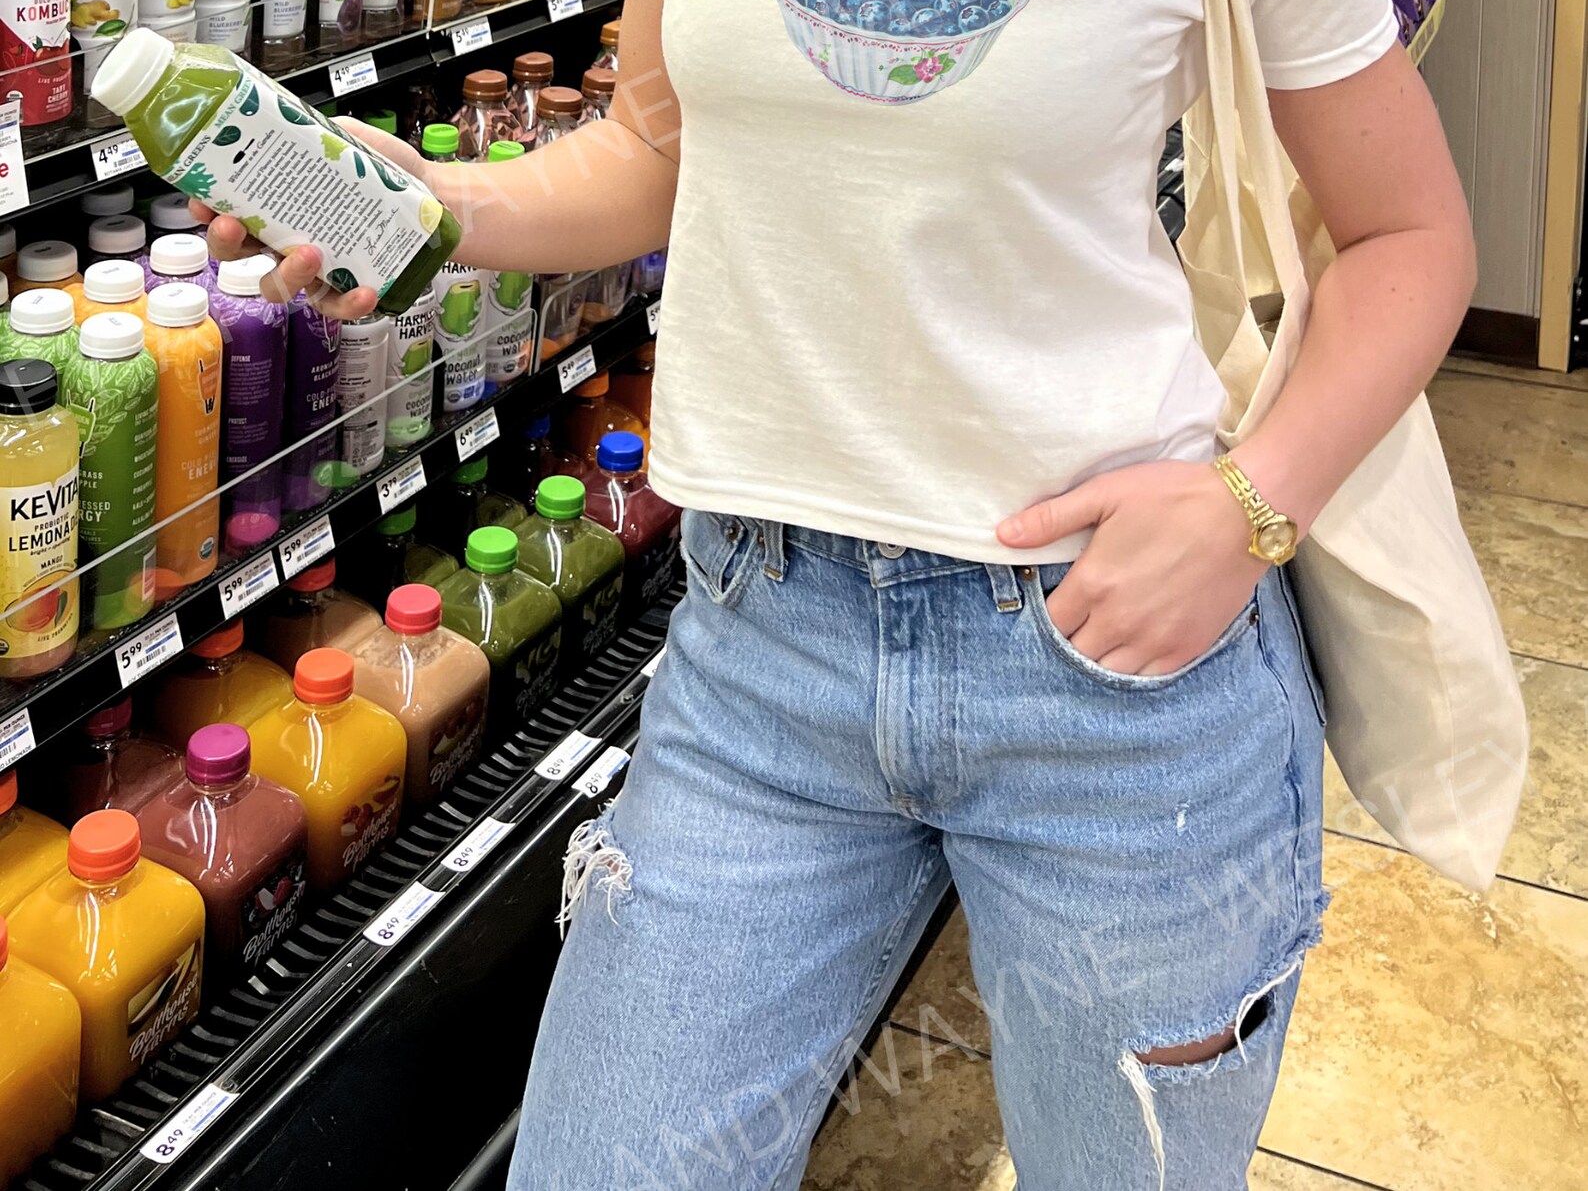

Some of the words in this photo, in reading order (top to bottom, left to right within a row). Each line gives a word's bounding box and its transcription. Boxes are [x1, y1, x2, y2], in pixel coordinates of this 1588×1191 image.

[334, 64, 350, 82] 449
[48, 91, 68, 102] CHERRY
[53, 84, 65, 93] TART
[213, 101, 237, 128] MEAN
[230, 76, 256, 104] GREEN
[99, 144, 118, 163] 449
[182, 133, 212, 168] GREENS
[562, 361, 574, 379] 549
[459, 427, 472, 446] 649
[381, 477, 397, 498] 379
[34, 512, 69, 532] PROBIOTIC
[284, 538, 301, 562] 599
[41, 555, 63, 569] MANGO
[224, 577, 242, 601] 599
[122, 642, 142, 669] 599
[546, 758, 565, 777] 849
[453, 847, 474, 867] 849
[378, 916, 400, 941] 849
[156, 1128, 183, 1157] 849
